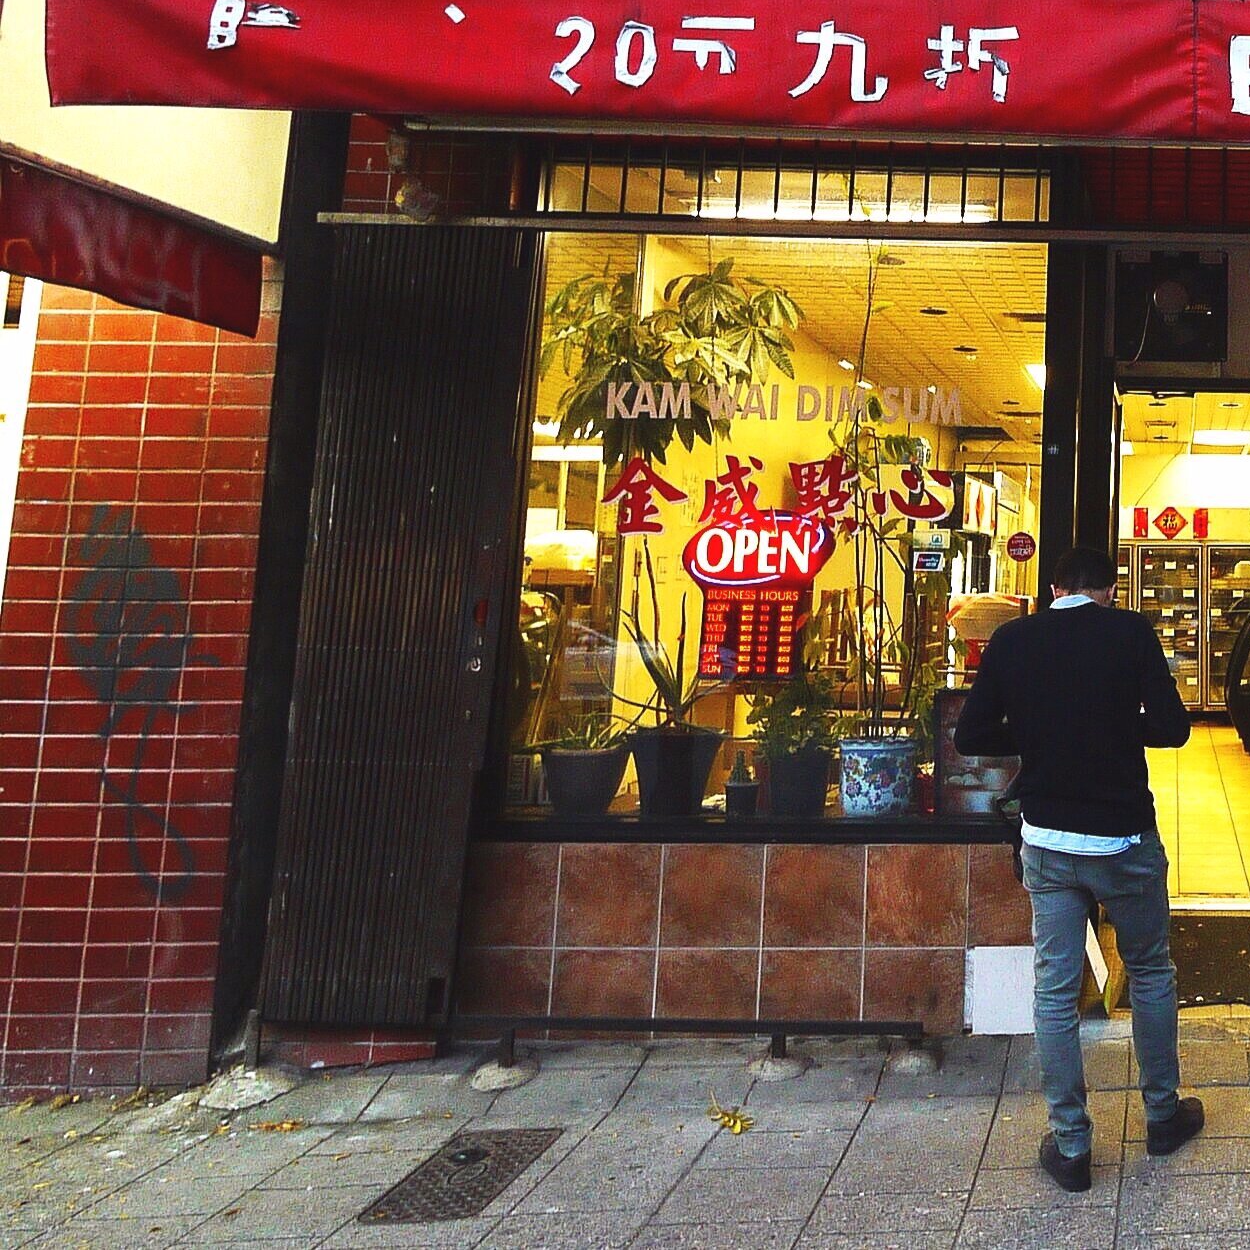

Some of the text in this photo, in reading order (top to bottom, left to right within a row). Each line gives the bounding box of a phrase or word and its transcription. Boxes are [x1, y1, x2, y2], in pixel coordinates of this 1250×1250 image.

[606, 381, 963, 424] KAM WAI DIM SUM
[602, 455, 955, 536] 金威點心
[696, 528, 811, 574] OPEN
[707, 590, 799, 601] BUSINESS HOURS
